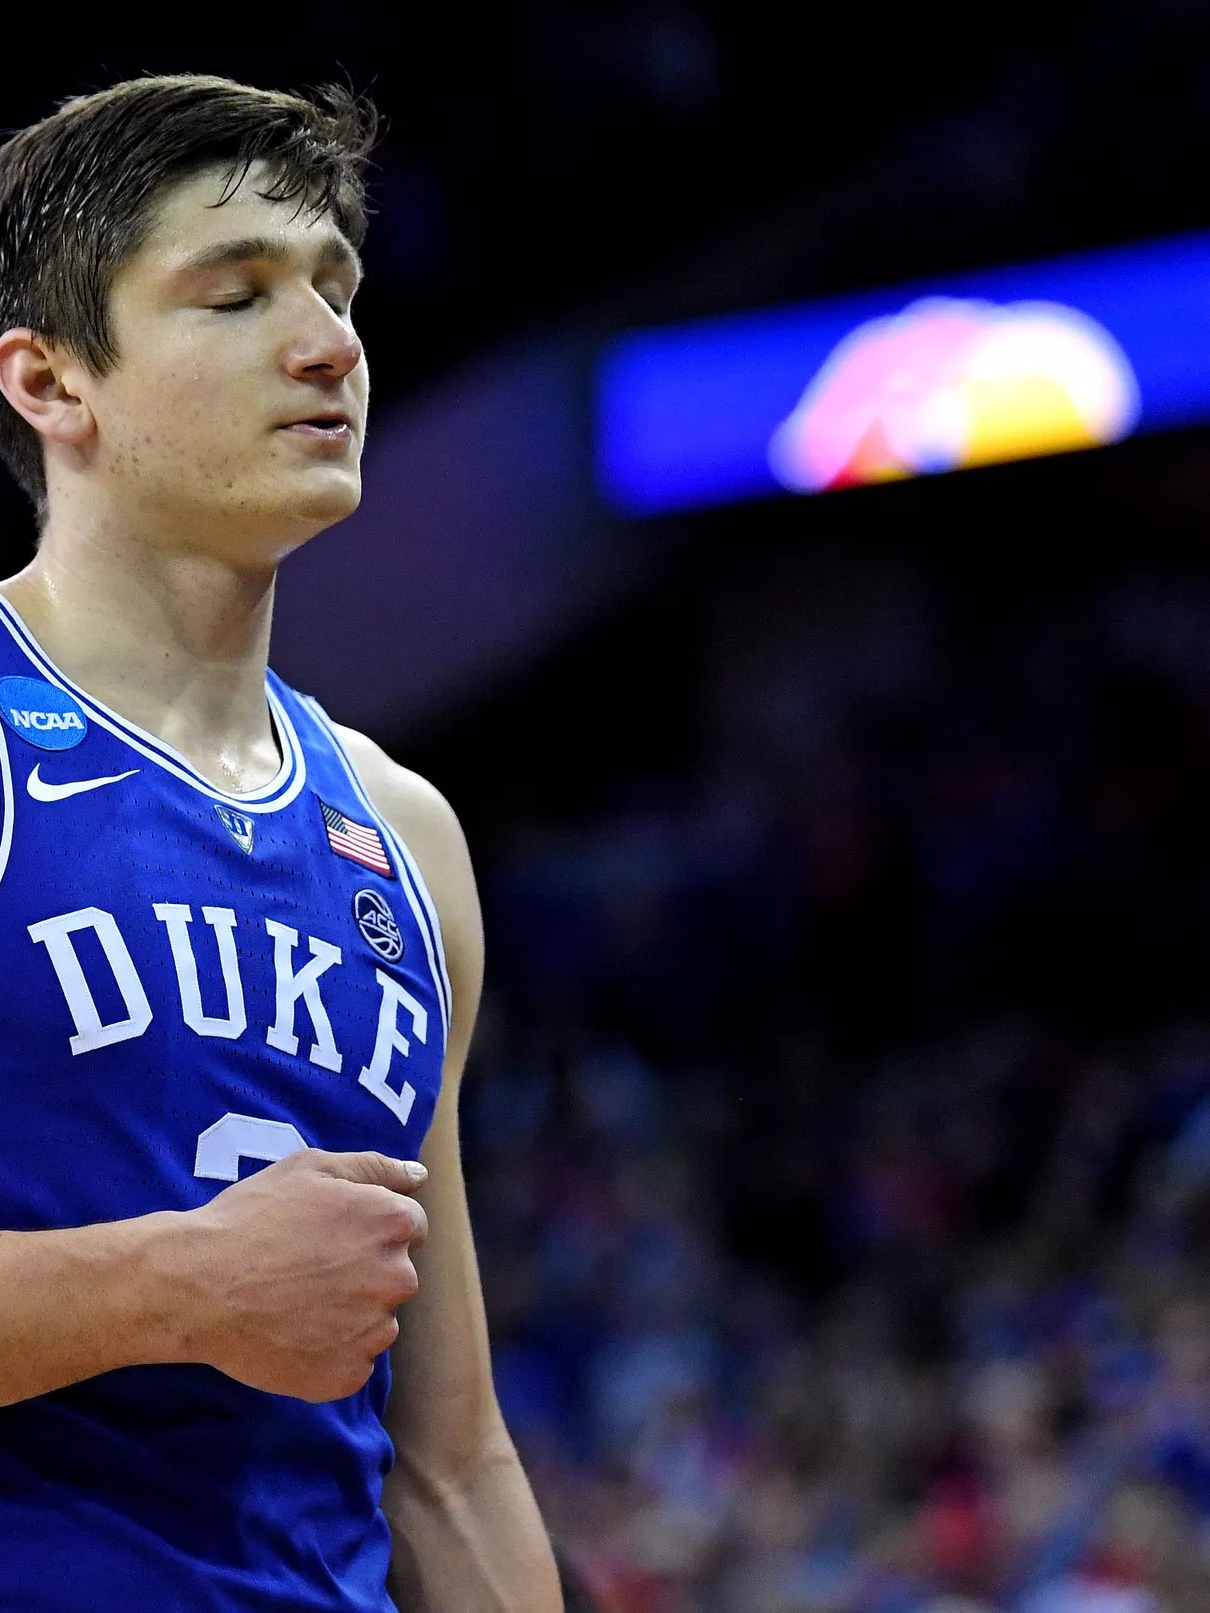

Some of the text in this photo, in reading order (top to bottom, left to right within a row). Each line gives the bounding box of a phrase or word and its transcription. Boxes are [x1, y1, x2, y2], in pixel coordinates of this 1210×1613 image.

[10, 708, 85, 730] NCAA
[362, 910, 398, 936] ACC
[27, 903, 428, 1126] DUKE
